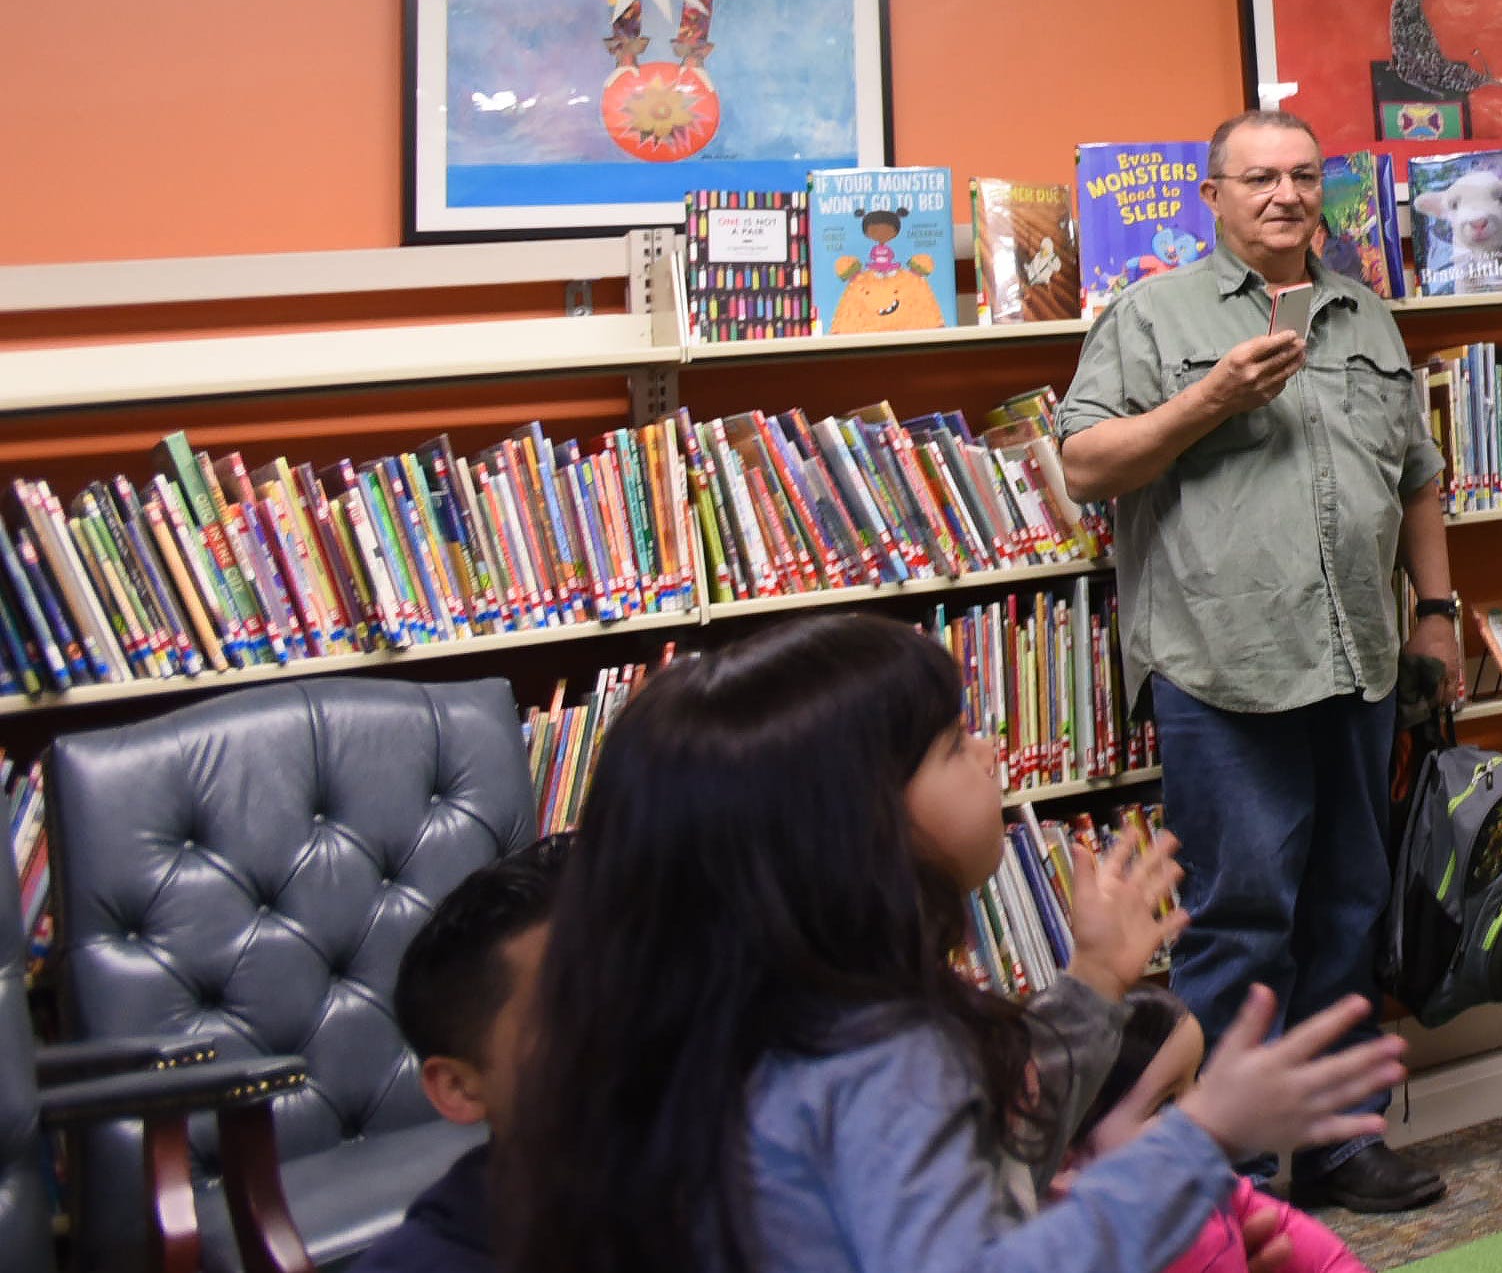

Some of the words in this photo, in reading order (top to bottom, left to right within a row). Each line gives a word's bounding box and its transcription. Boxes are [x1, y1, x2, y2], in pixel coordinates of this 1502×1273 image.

[1117, 152, 1163, 170] Even
[815, 177, 828, 194] IF
[838, 176, 873, 193] YOUR
[878, 173, 945, 192] MONSTER
[1086, 163, 1198, 200] MONSTERS
[871, 196, 891, 212] GO
[898, 194, 916, 210] TO
[920, 193, 944, 211] BED
[1115, 186, 1156, 207] Need
[1163, 184, 1181, 199] to
[1119, 200, 1182, 226] SLEEP
